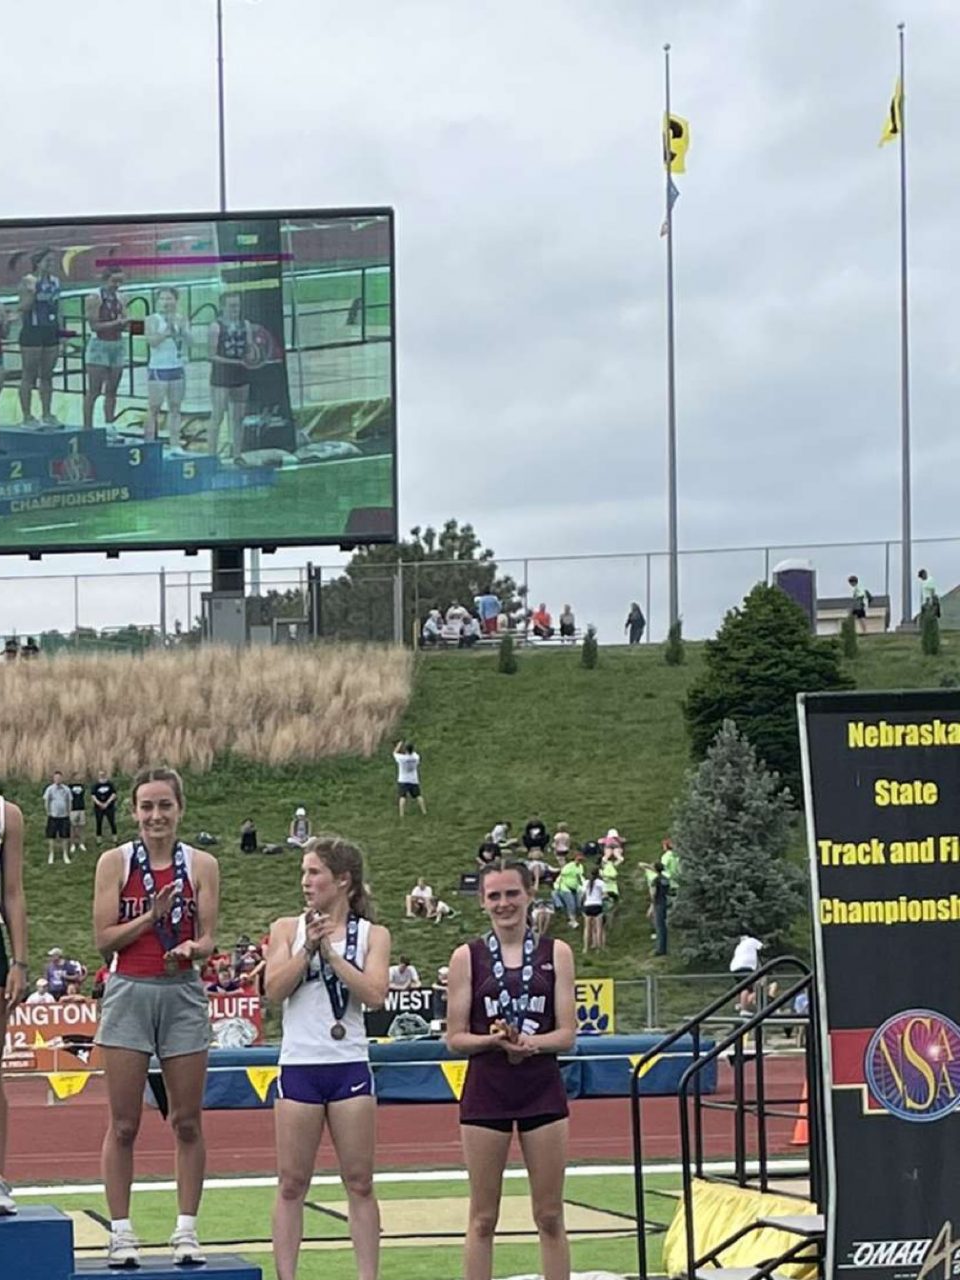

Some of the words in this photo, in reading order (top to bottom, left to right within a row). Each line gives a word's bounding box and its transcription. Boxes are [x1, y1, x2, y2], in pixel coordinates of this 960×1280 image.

[68, 436, 79, 454] 1
[128, 447, 142, 466] 3
[9, 461, 23, 479] 2
[182, 461, 196, 480] 5
[10, 486, 130, 513] CHAMPIONSHIPS
[848, 720, 960, 748] Nebraska
[874, 778, 939, 806] State
[818, 838, 886, 866] Track
[889, 837, 935, 864] and
[384, 989, 433, 1012] WEST
